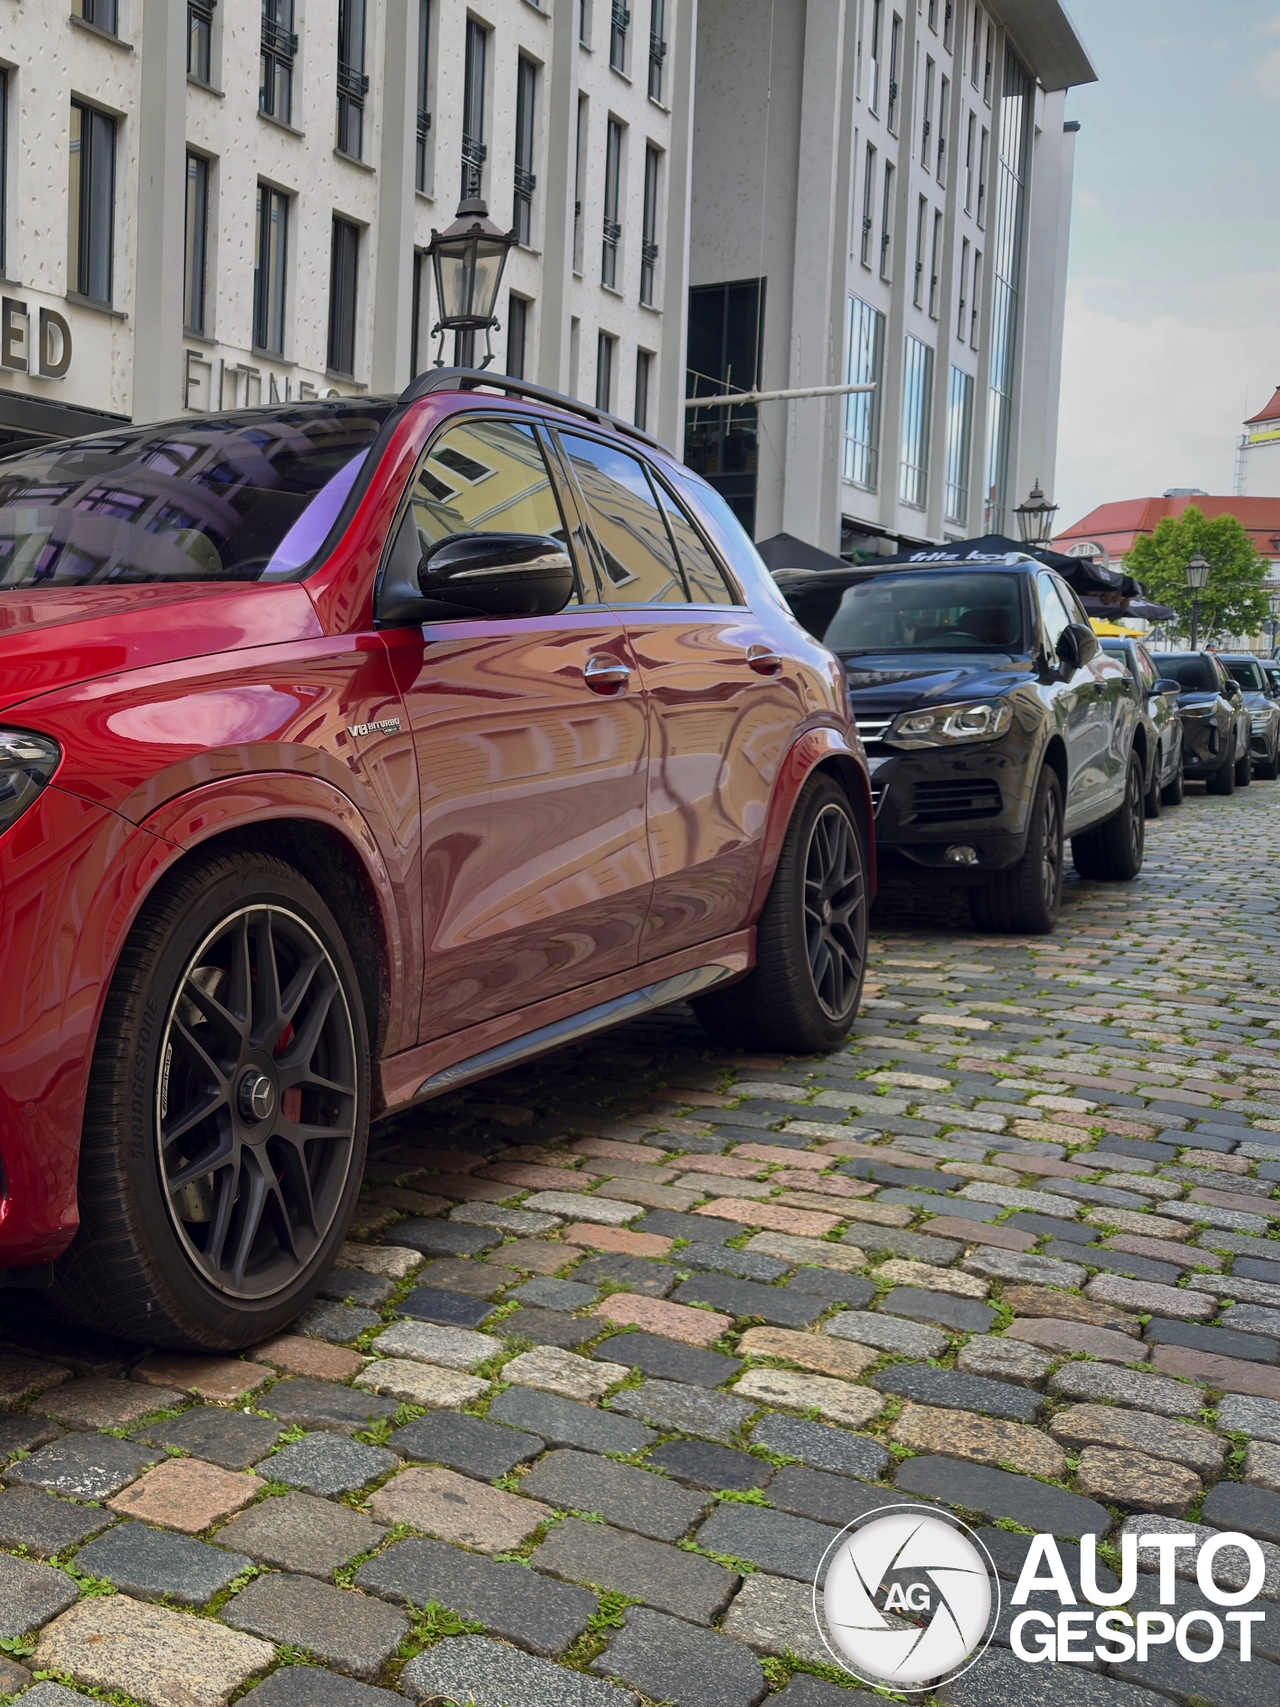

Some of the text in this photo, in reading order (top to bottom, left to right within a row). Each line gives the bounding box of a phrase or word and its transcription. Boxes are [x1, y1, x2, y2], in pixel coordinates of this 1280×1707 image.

[908, 549, 1012, 562] fritz kol
[347, 723, 369, 738] V8
[367, 717, 400, 730] BITURBO
[131, 996, 159, 1159] BRIDGESTONE
